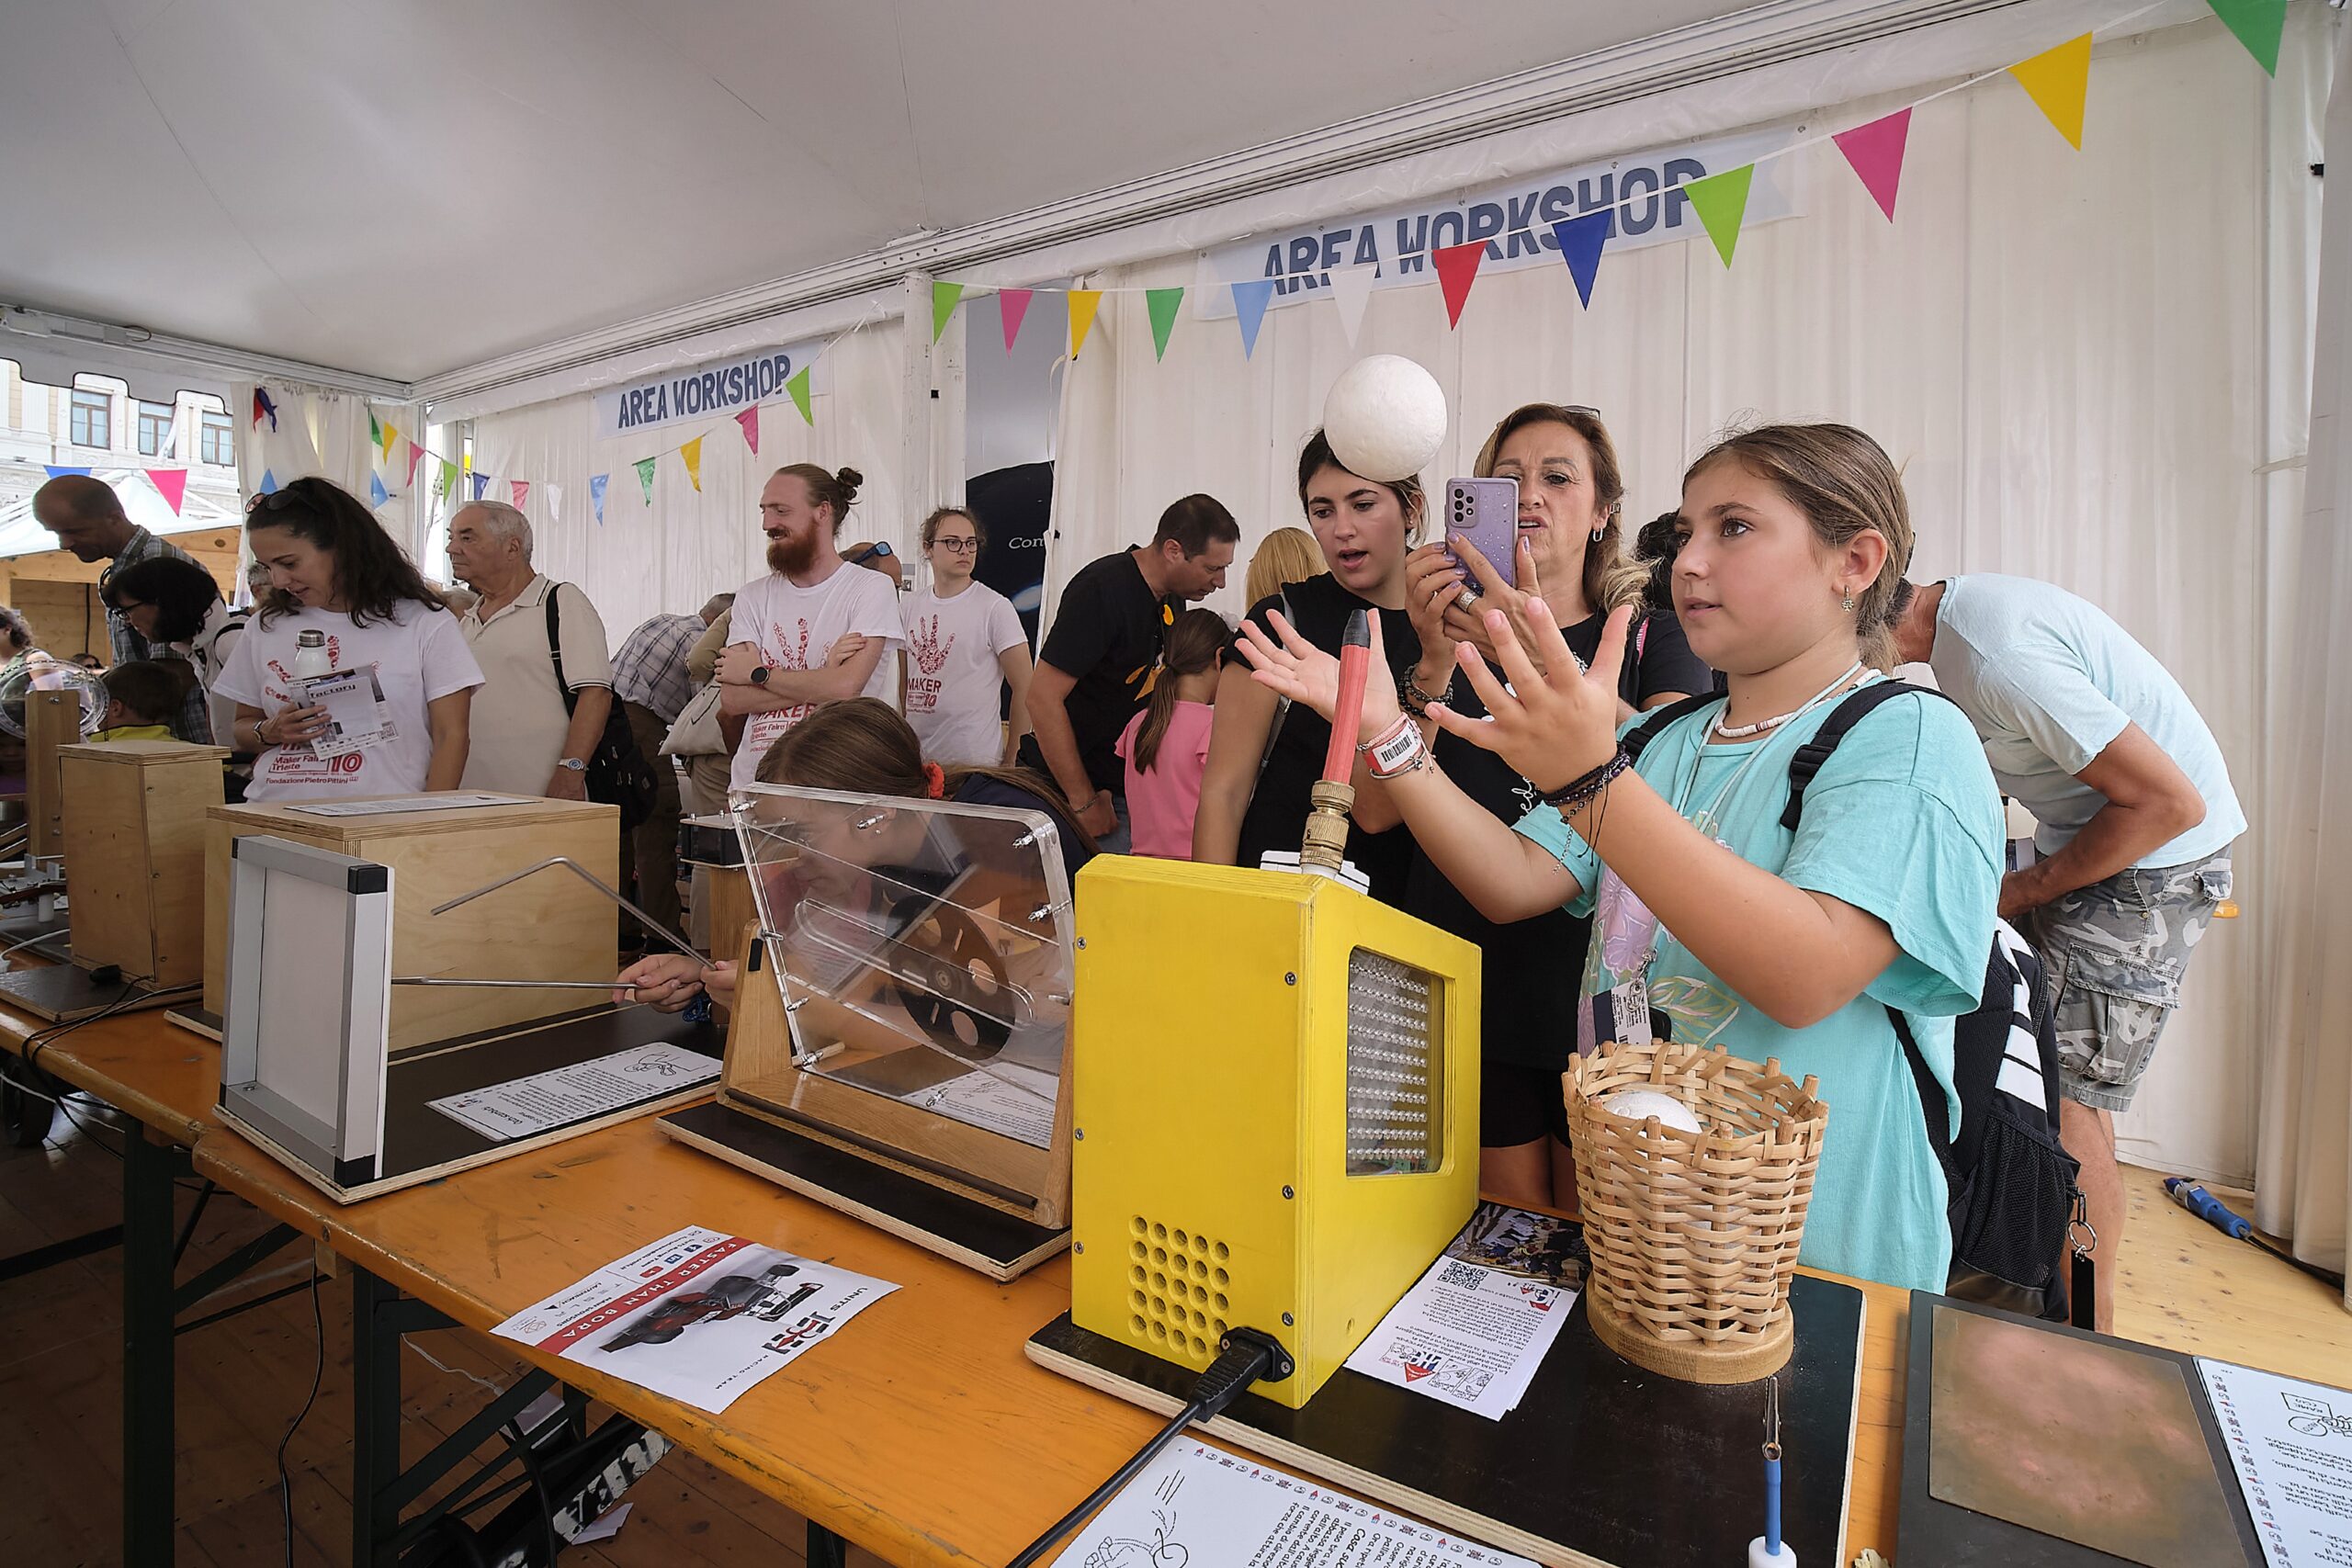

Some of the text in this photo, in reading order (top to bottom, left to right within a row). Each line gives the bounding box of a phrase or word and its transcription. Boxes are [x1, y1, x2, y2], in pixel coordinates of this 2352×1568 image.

[1264, 158, 1707, 296] AREA WORKSHOP
[618, 355, 791, 429] AREA WORKSHOP
[908, 677, 942, 693] MAKER
[271, 762, 301, 771] Trieste
[275, 755, 302, 764] Maker
[331, 752, 363, 773] 10
[266, 776, 304, 785] Fondazione
[327, 776, 348, 784] Pittini
[678, 1243, 737, 1276] FASTER
[624, 1280, 674, 1305] THAN
[830, 1287, 868, 1311] UNITS
[562, 1309, 617, 1337] BORA
[715, 1354, 769, 1390] RACING TEAM
[2272, 1459, 2316, 1475] metallo,
[2301, 1456, 2319, 1464] con
[2285, 1496, 2301, 1505] cui
[2303, 1502, 2323, 1512] tra
[1284, 1510, 1305, 1535] cambio
[1297, 1509, 1320, 1540] corrente
[1306, 1514, 1330, 1545] dall'alto.
[1317, 1517, 1340, 1547] abbassa
[1248, 1502, 1300, 1567] forza che attira la
[1333, 1526, 1348, 1543] peso
[1367, 1532, 1381, 1547] Ora
[1323, 1544, 1339, 1559] tira
[1335, 1528, 1366, 1568] Cosa suc
[1374, 1536, 1393, 1562] pallina.
[1318, 1559, 1329, 1567] in
[1437, 1558, 1452, 1568] l'a
